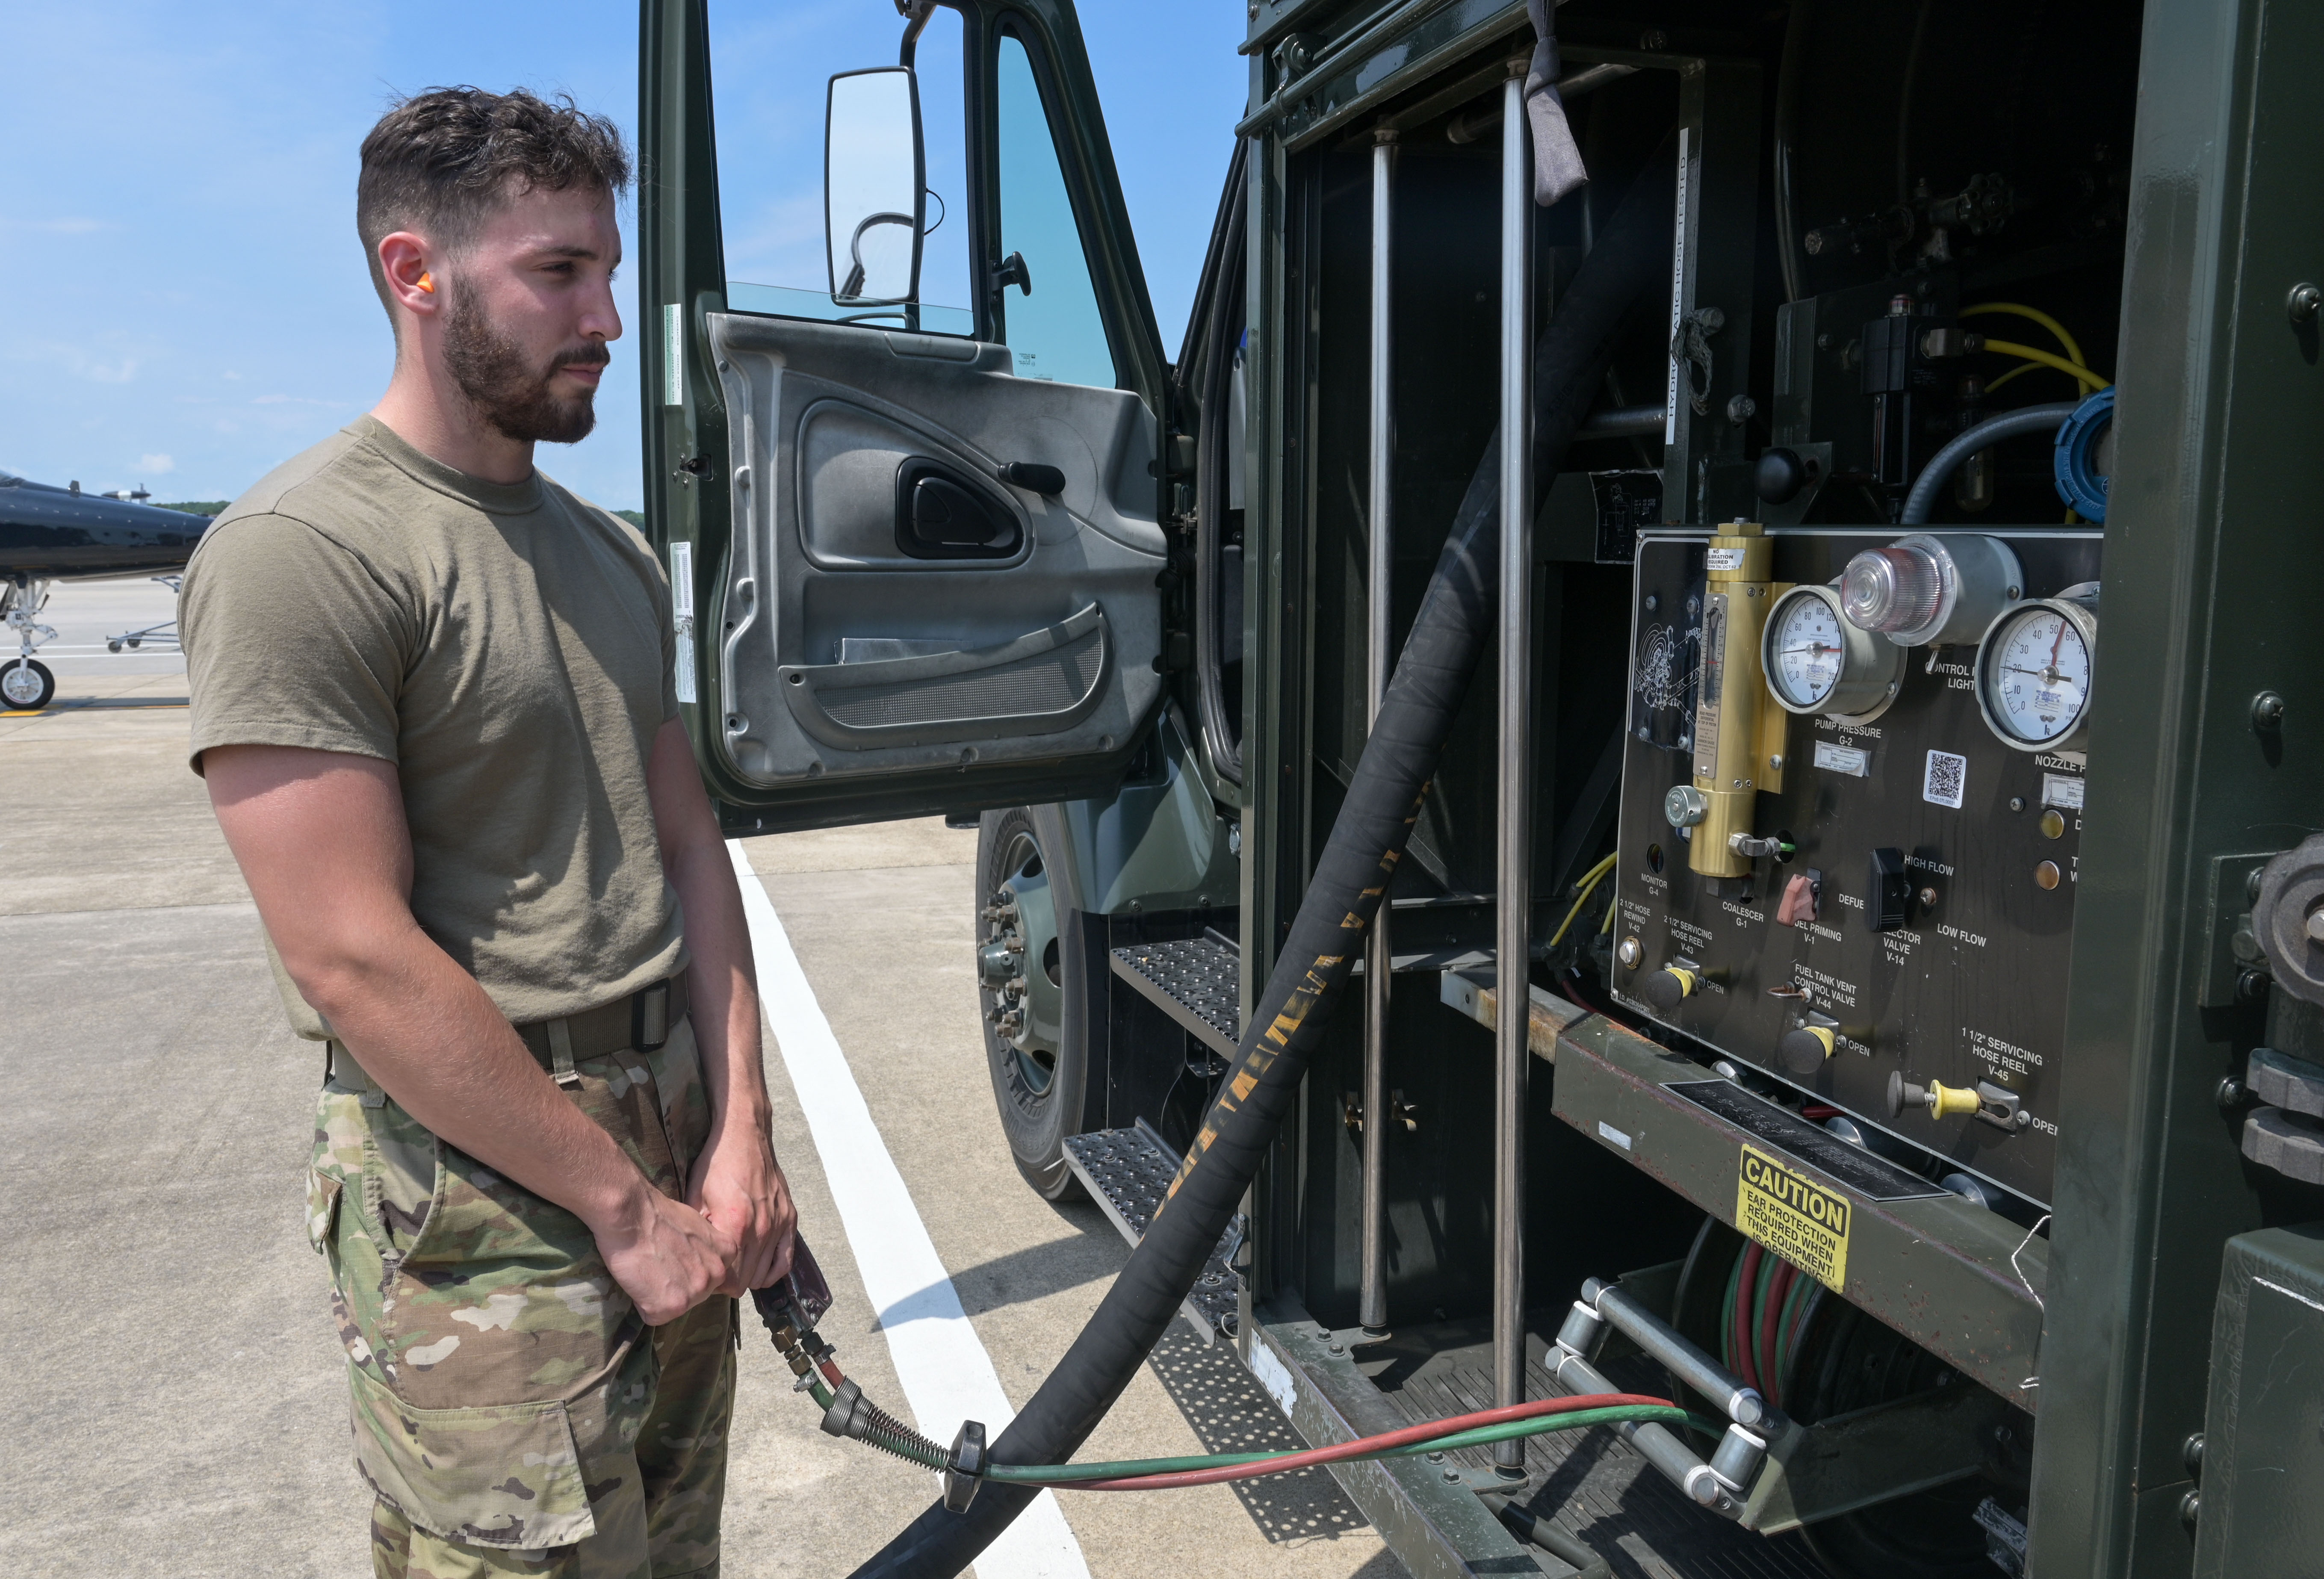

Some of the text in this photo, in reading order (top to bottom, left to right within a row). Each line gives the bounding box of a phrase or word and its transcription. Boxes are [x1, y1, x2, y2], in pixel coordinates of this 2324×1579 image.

[1669, 291, 1680, 416] HYDROATIC
[1804, 612, 1811, 620] 80
[1816, 607, 1825, 615] 100
[1795, 623, 1801, 631] 60
[2049, 625, 2059, 634] 50
[1790, 638, 1796, 646] 40
[2033, 630, 2042, 640] 40
[2066, 631, 2075, 641] 60
[2020, 645, 2029, 654] 30
[1790, 656, 1797, 664] 20
[2012, 664, 2022, 673] 20
[2083, 665, 2088, 675] 8
[1828, 672, 1837, 681] 20
[2014, 685, 2021, 695] 10
[2081, 687, 2086, 697] 9
[2021, 701, 2026, 710] 0
[1815, 719, 1882, 738] PUMP PRESSURE
[1839, 735, 1853, 746] G-2
[2035, 754, 2076, 771] NOZZLE
[1904, 854, 1954, 877] HIGH FLOW
[1641, 873, 1668, 889] MONITOR
[1649, 886, 1659, 896] G-4
[1624, 900, 1634, 909] 1/2"
[1635, 903, 1651, 916] HOSE
[1839, 893, 1864, 909] DEFUE
[1624, 910, 1646, 924] REWIND
[1722, 901, 1764, 923] COALESCER
[1628, 921, 1640, 933] V-42
[1669, 917, 1679, 927] 1/2"
[1680, 921, 1713, 940] SERVICING
[1736, 917, 1747, 928] G-1
[1671, 928, 1704, 948] HOSE REEL
[1794, 920, 1842, 942] UEL PRIMING
[1804, 933, 1815, 944] V-1
[1883, 929, 1921, 945] ECTOR
[1937, 923, 1987, 947] LOW FLOW
[1681, 942, 1693, 954] V-43
[1883, 937, 1911, 955] VALVE
[1887, 951, 1904, 966] V-14
[1795, 963, 1857, 995] FUEL TANK VENT
[1707, 980, 1724, 995] OPEN
[1795, 975, 1855, 1007] CONTROL VALVE
[1816, 995, 1831, 1009] V-44
[1848, 1039, 1870, 1057] OPEN
[1962, 1027, 2043, 1066] 1 1/2" SERVICING
[1973, 1044, 2028, 1075] HOSE REEL
[1988, 1064, 2009, 1081] V-45
[1746, 1157, 1843, 1233] CAUTION
[1748, 1190, 1836, 1251] EAR PROTECTION
[1748, 1203, 1833, 1263] REQUIRED WHEN
[1753, 1231, 1762, 1245] IS
[1747, 1216, 1833, 1276] THIS EQUIPMENT
